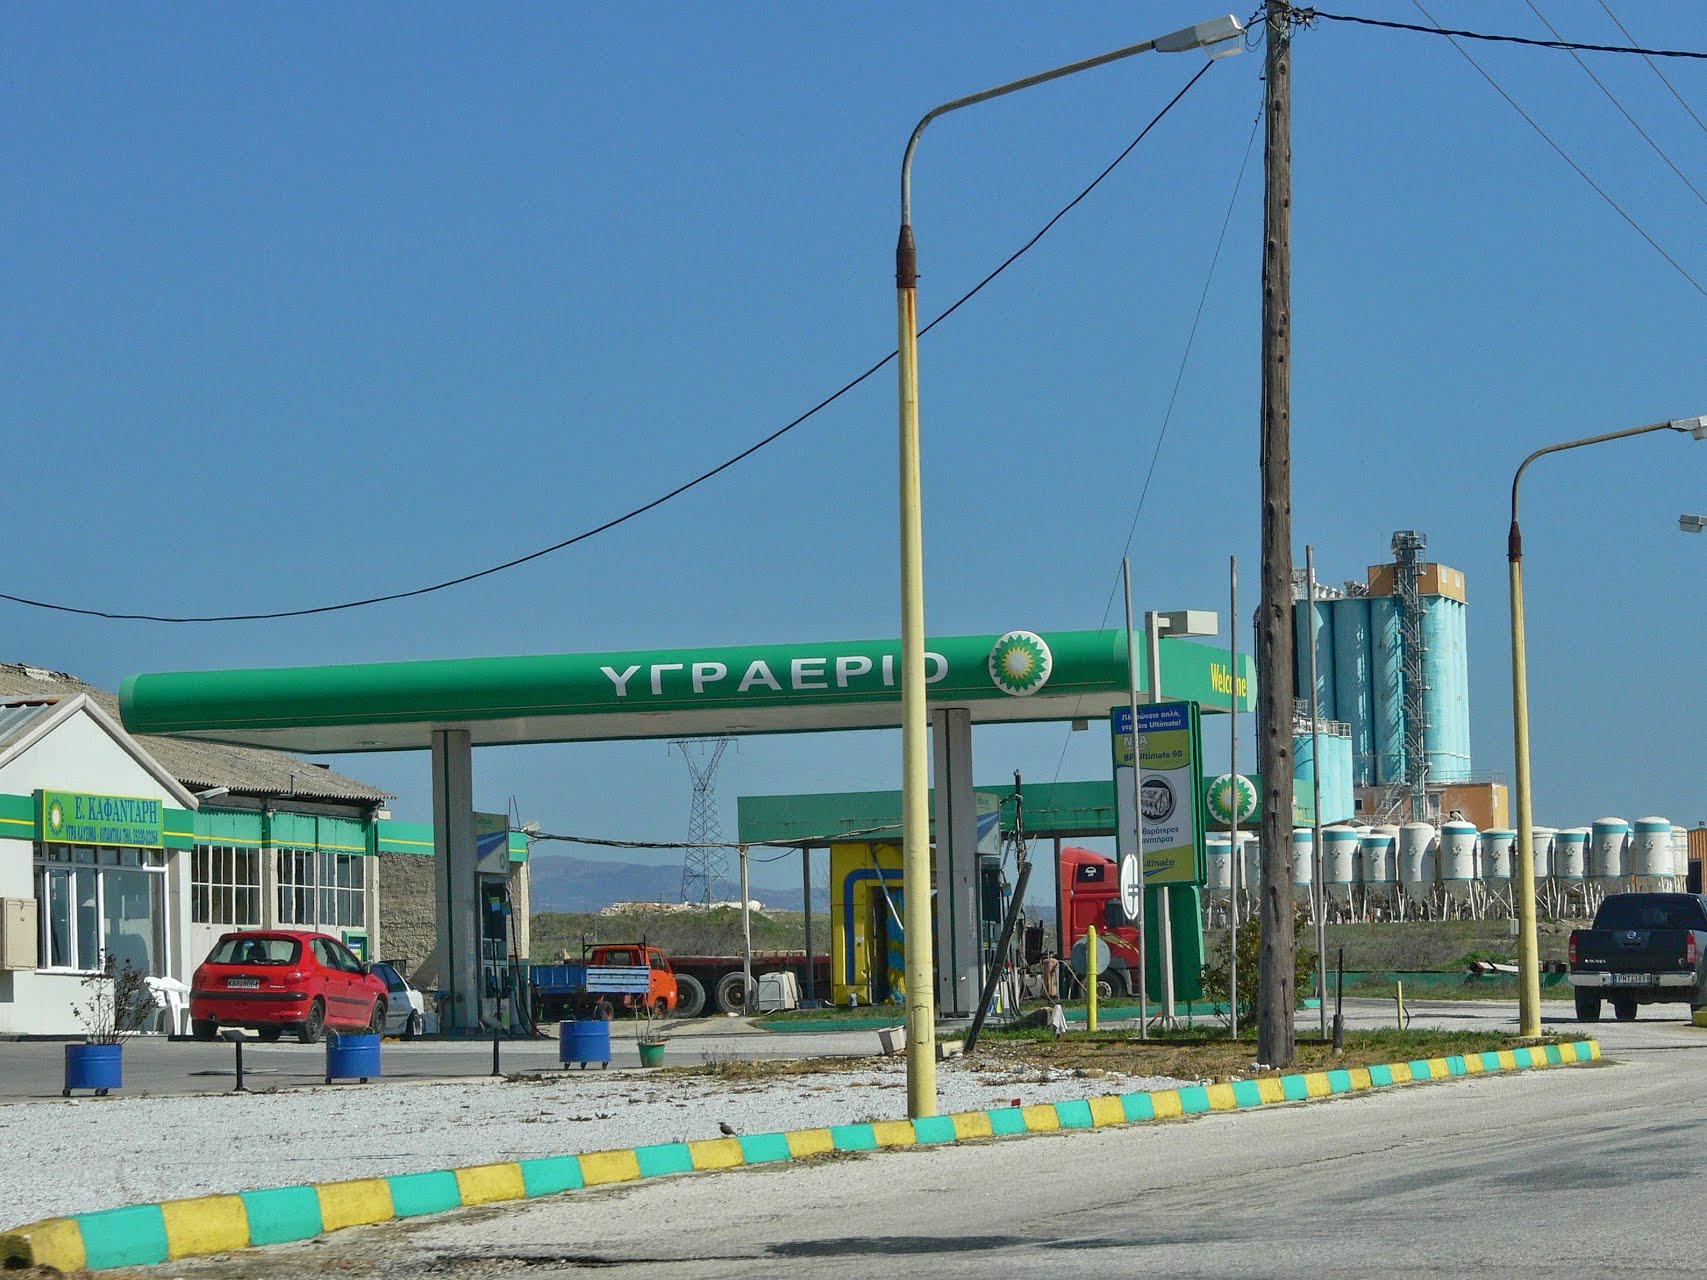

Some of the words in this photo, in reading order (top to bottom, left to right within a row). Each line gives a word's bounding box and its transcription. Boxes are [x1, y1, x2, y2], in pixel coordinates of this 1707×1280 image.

[600, 652, 949, 697] ΥΓΡΑΕΡΙΟ
[1121, 712, 1159, 721] Πλρώνεις
[1149, 719, 1182, 728] Ultimate!
[88, 797, 158, 824] ΚΑΦΑΝΤΑΡΗ
